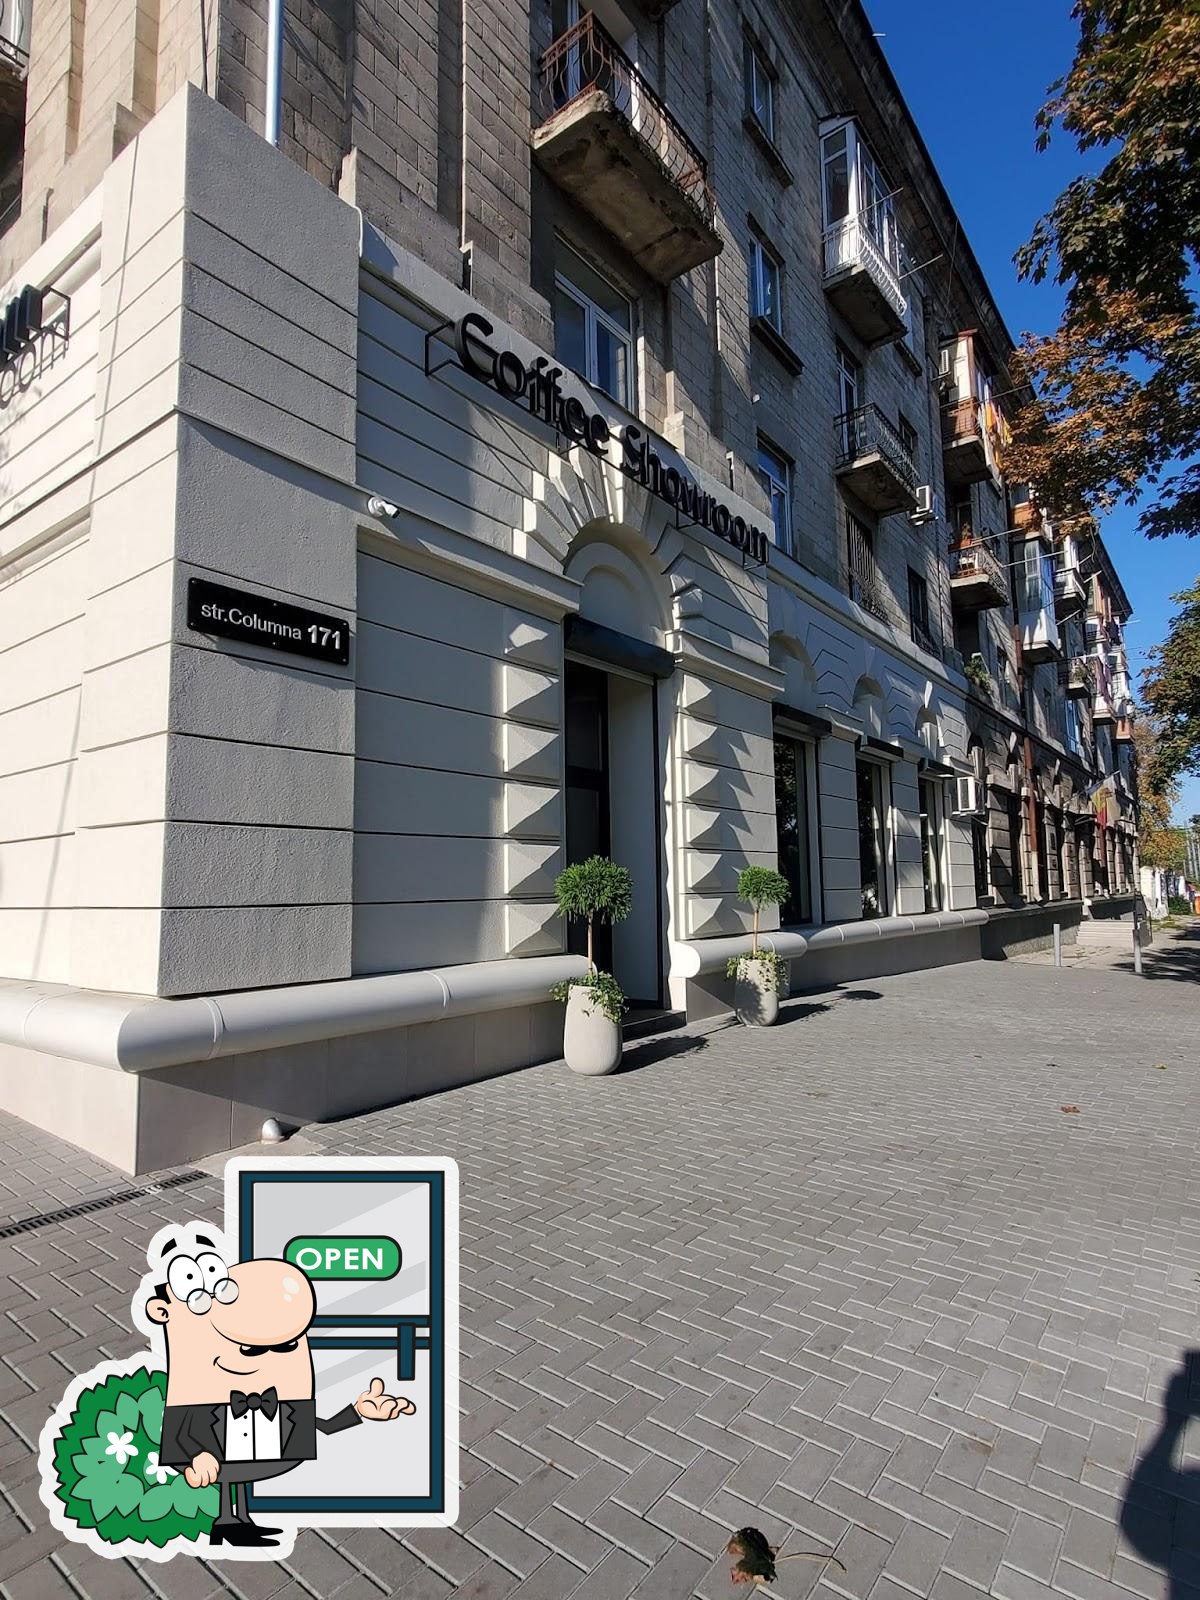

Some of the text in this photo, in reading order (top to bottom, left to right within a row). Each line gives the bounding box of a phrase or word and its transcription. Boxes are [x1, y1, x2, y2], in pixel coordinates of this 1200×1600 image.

[455, 312, 769, 563] Coffee Showroom
[201, 603, 341, 650] str.Columna 171
